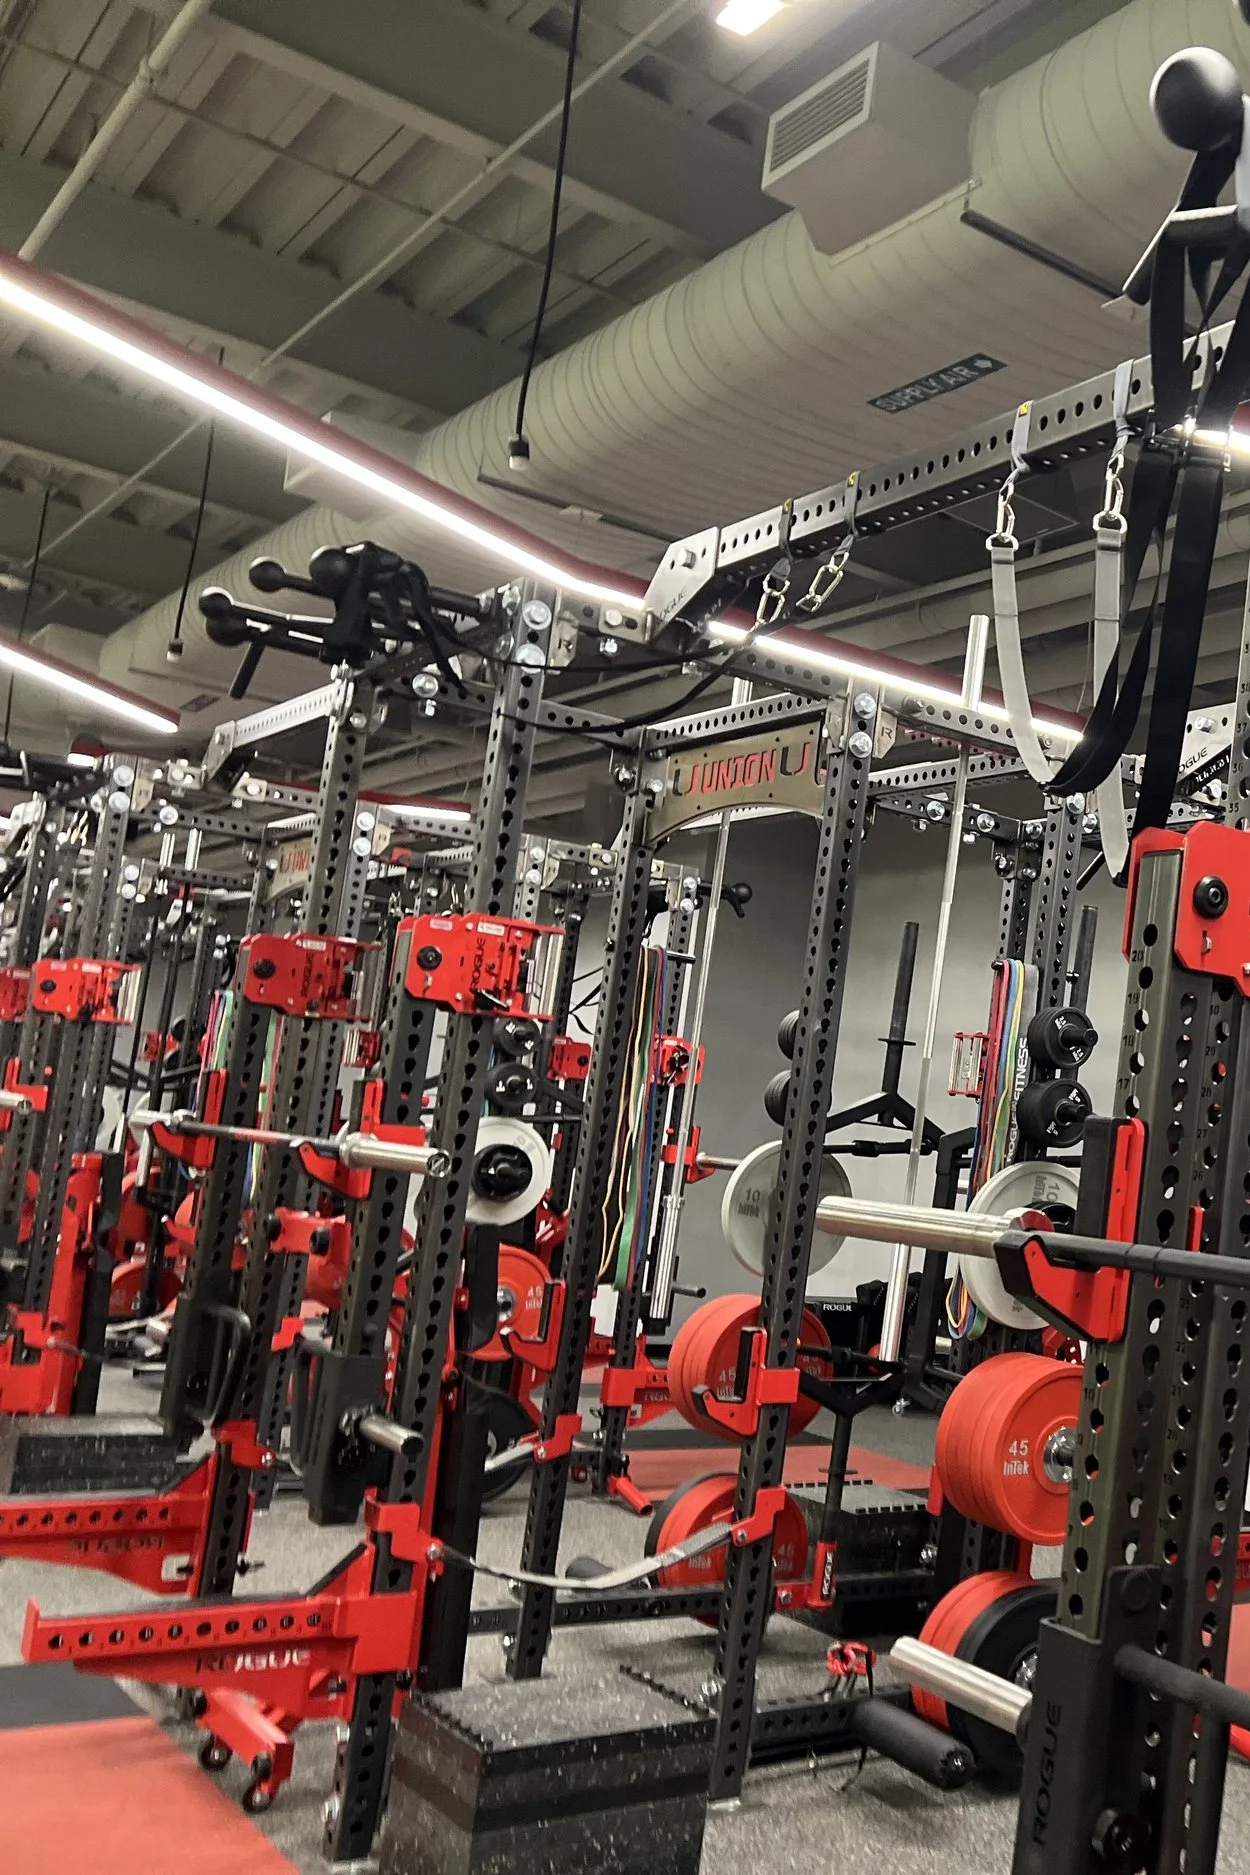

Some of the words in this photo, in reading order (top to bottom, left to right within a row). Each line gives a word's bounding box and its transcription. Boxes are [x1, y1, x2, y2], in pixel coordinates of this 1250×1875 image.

[875, 378, 945, 411] SUPPLY
[939, 365, 979, 385] AIR
[881, 726, 892, 739] R
[1236, 722, 1247, 733] 37
[1178, 747, 1208, 774] OGUE
[700, 748, 777, 794] UNION
[1232, 763, 1243, 774] 36
[1228, 802, 1239, 813] 35
[1132, 950, 1144, 962] 20
[1128, 993, 1139, 1004] 19
[1123, 1035, 1134, 1047] 18
[1118, 1078, 1130, 1090] 17
[746, 1188, 760, 1201] 10
[1084, 1387, 1095, 1401] 10
[1009, 1438, 1029, 1456] 45
[1003, 1460, 1029, 1476] InTek
[1032, 1702, 1062, 1848] ROGUE
